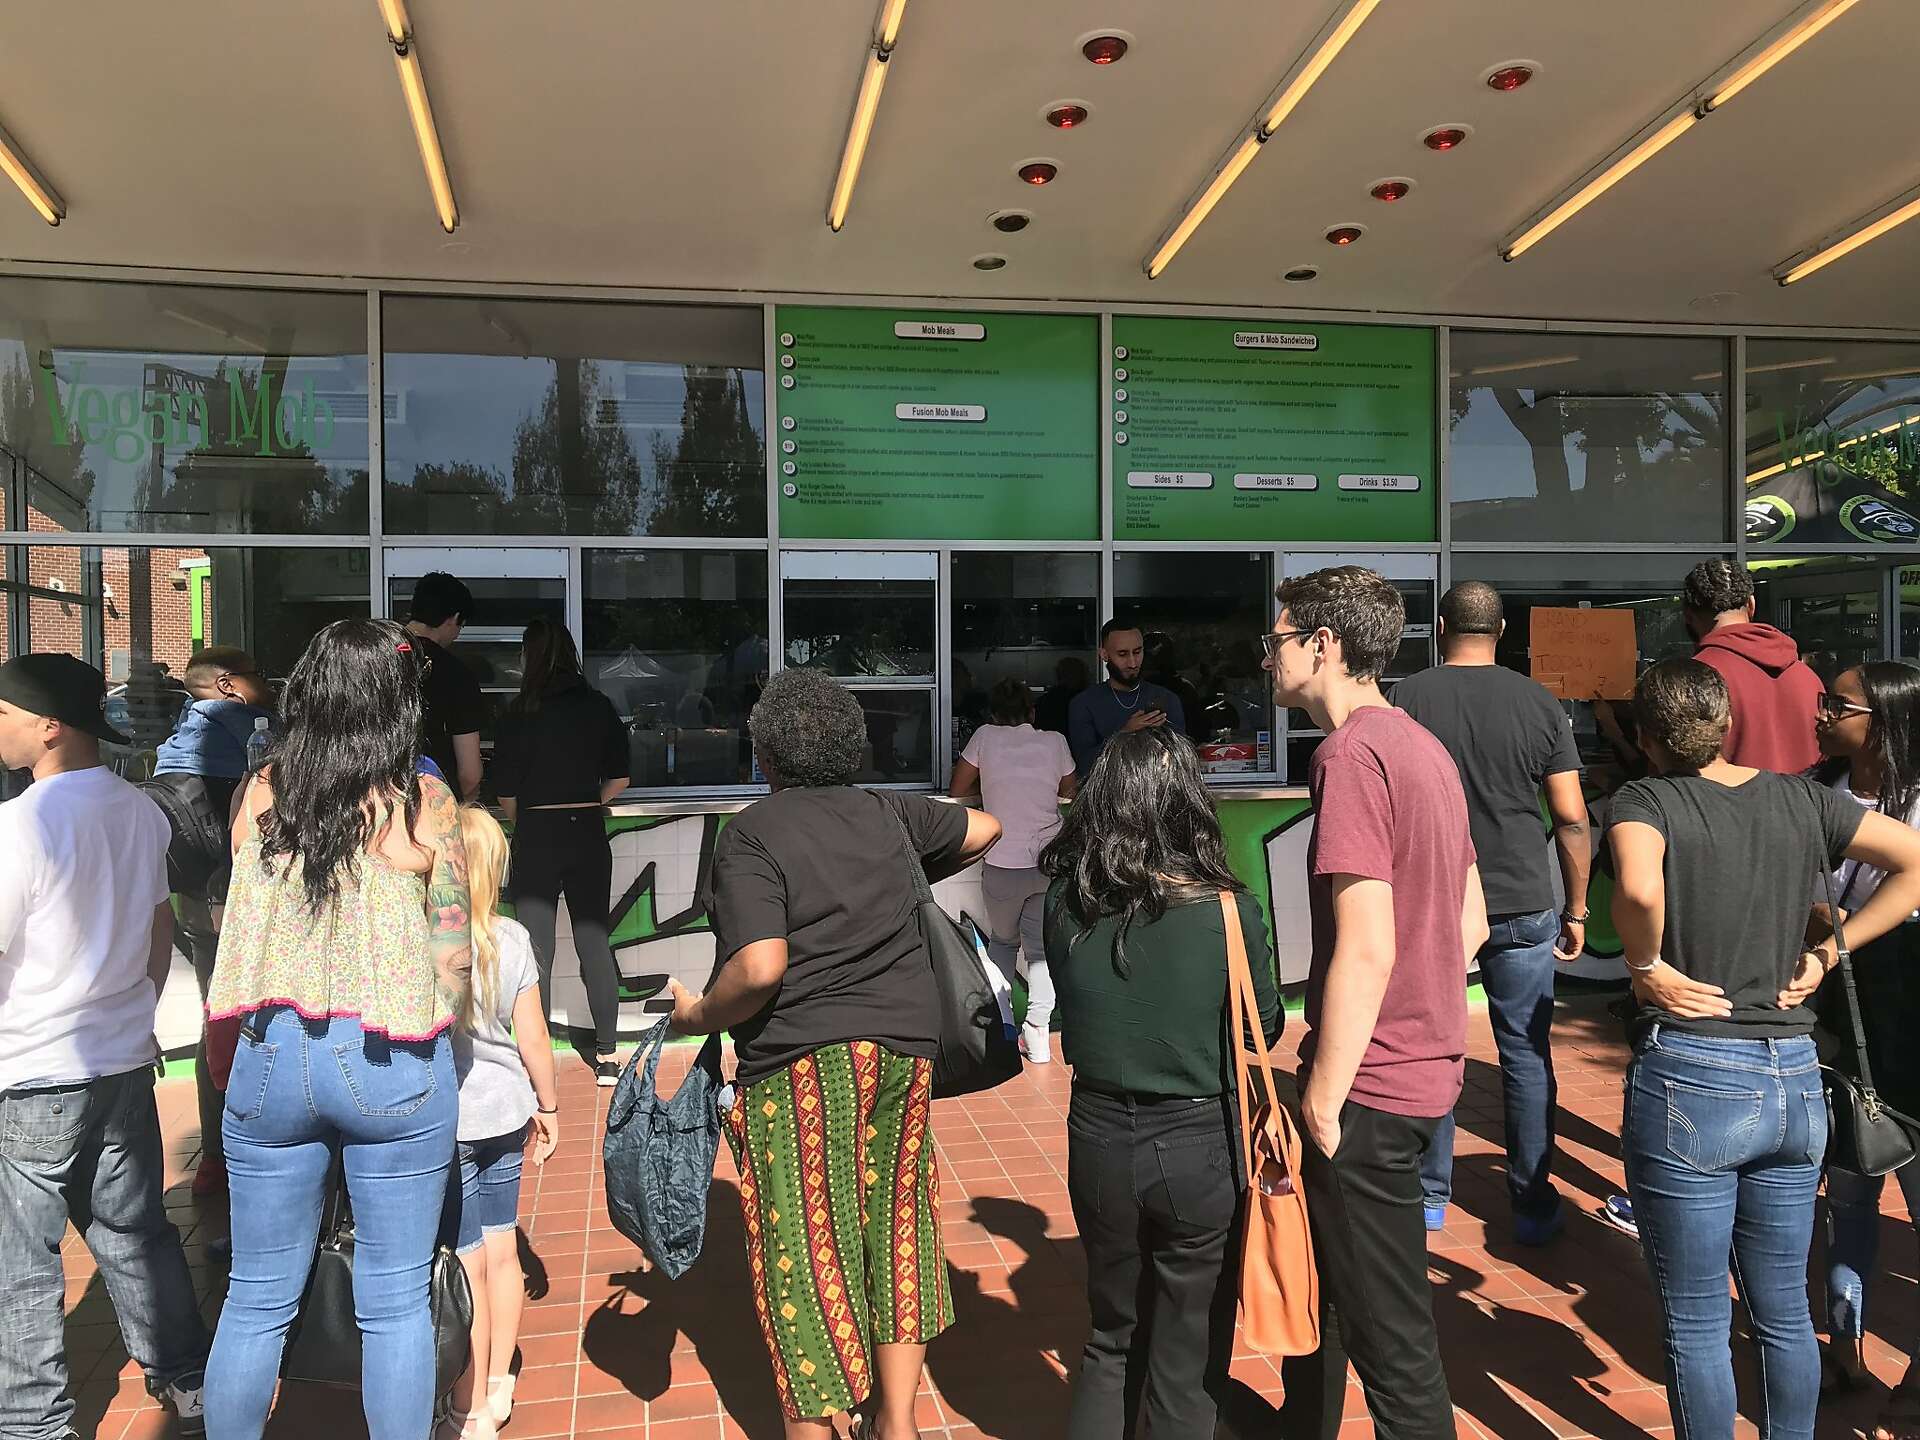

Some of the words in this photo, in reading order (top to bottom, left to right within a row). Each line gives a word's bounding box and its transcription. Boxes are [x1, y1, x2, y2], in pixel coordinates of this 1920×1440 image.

[922, 325, 936, 335] Mob
[937, 325, 956, 335] Meals
[1235, 333, 1259, 344] Burgers
[1260, 335, 1265, 343] &
[1266, 335, 1279, 344] Mob
[1280, 336, 1315, 345] Sandwiches
[40, 359, 212, 464] Vegan
[225, 367, 336, 457] Mob
[912, 406, 934, 416] Fusion
[935, 407, 949, 416] Mob
[950, 407, 969, 417] Meals
[1154, 474, 1171, 484] Sides
[1176, 474, 1184, 484] $5
[1256, 476, 1282, 486] Desserts
[1286, 477, 1295, 486] $5
[1360, 477, 1378, 487] Drinks
